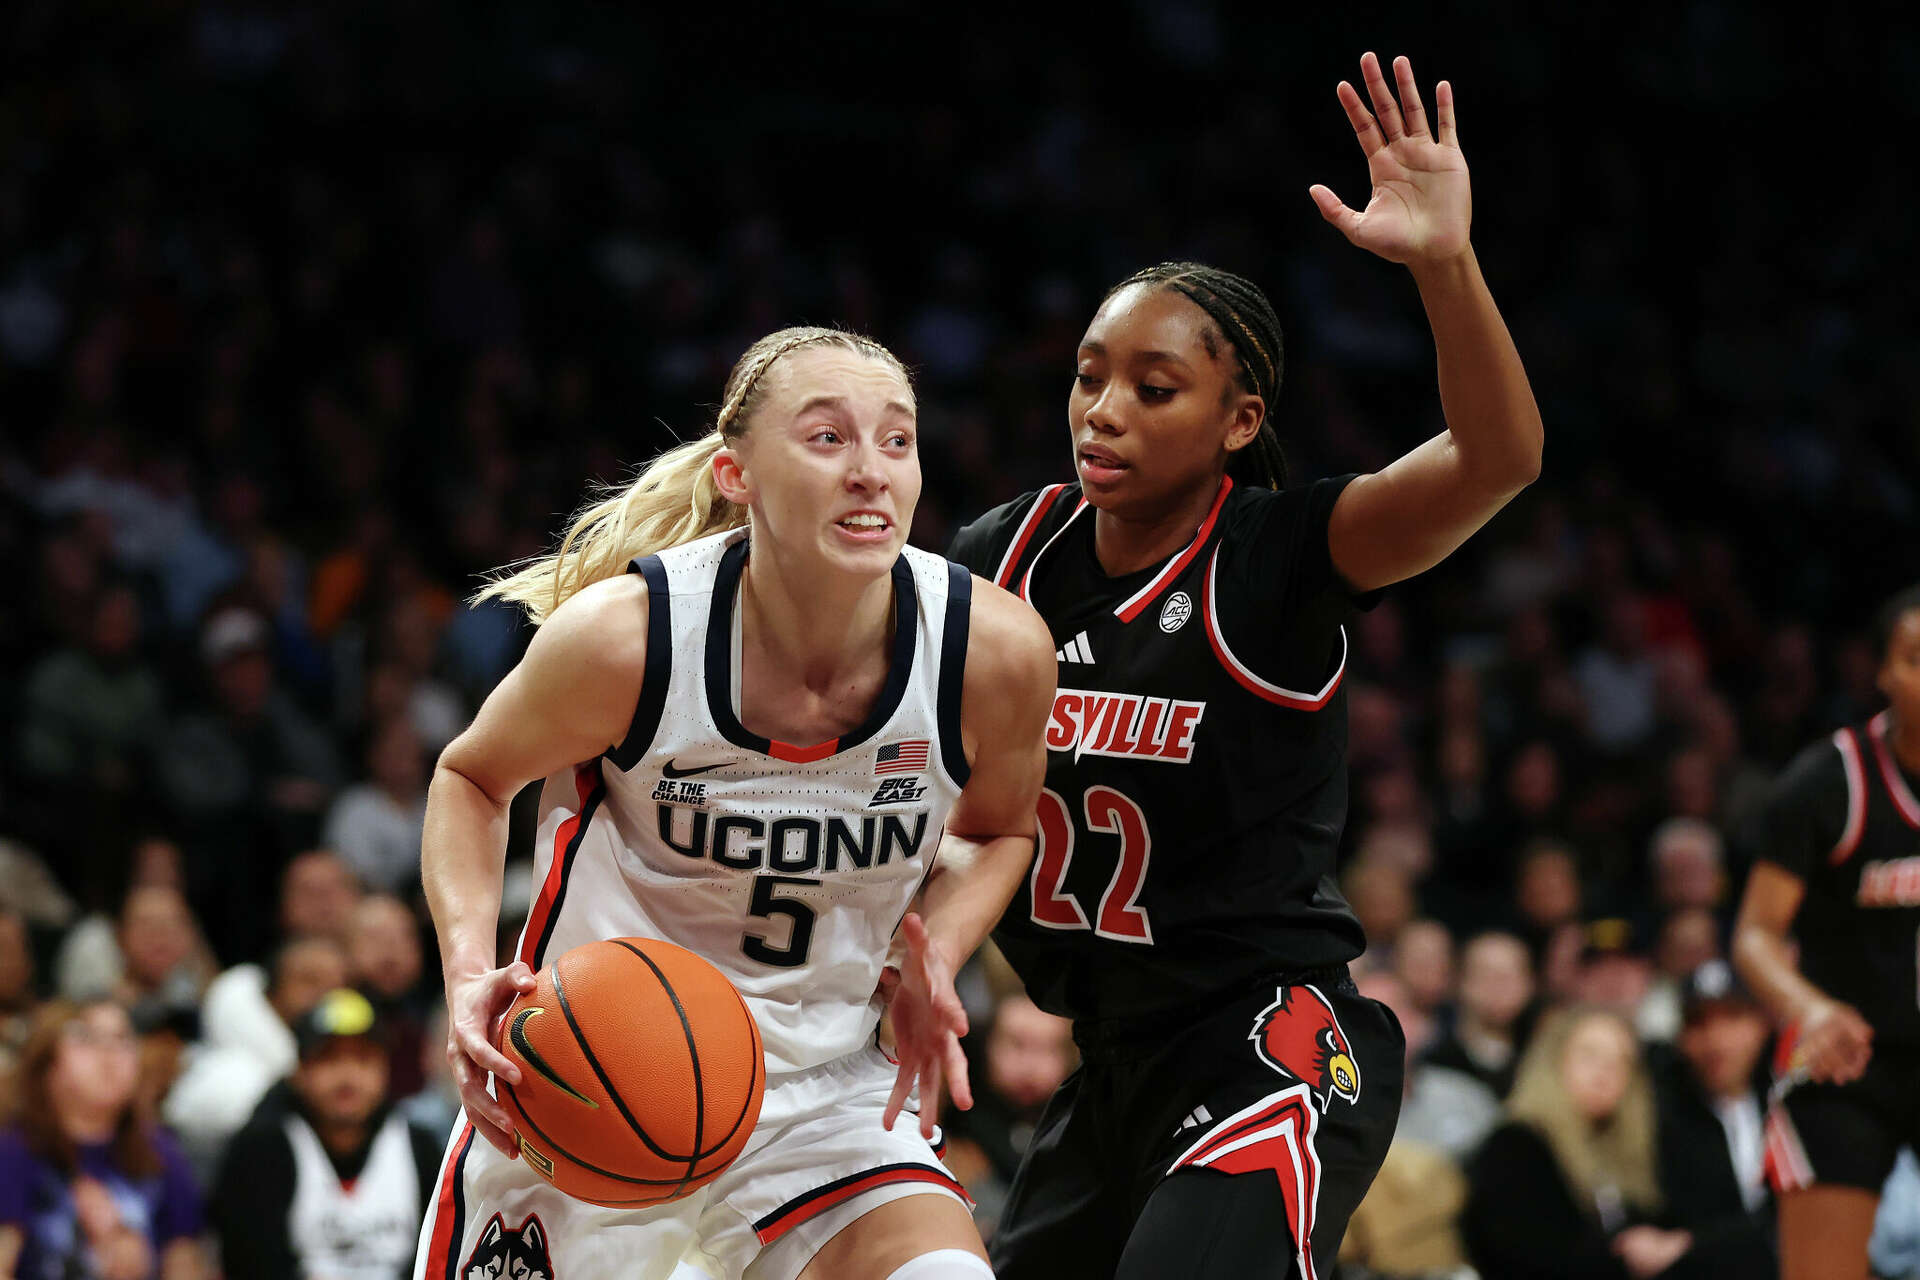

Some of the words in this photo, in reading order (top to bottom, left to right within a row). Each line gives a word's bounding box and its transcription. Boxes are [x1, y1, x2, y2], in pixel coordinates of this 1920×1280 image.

[1165, 605, 1190, 616] ACC
[1045, 687, 1206, 765] SVILLE
[657, 779, 677, 794] BE
[680, 782, 706, 797] THE
[879, 777, 920, 790] BIG
[651, 790, 707, 806] CHANGE
[871, 786, 928, 801] EAST
[656, 802, 929, 874] UCONN
[1030, 785, 1154, 946] 22
[739, 875, 823, 967] 5
